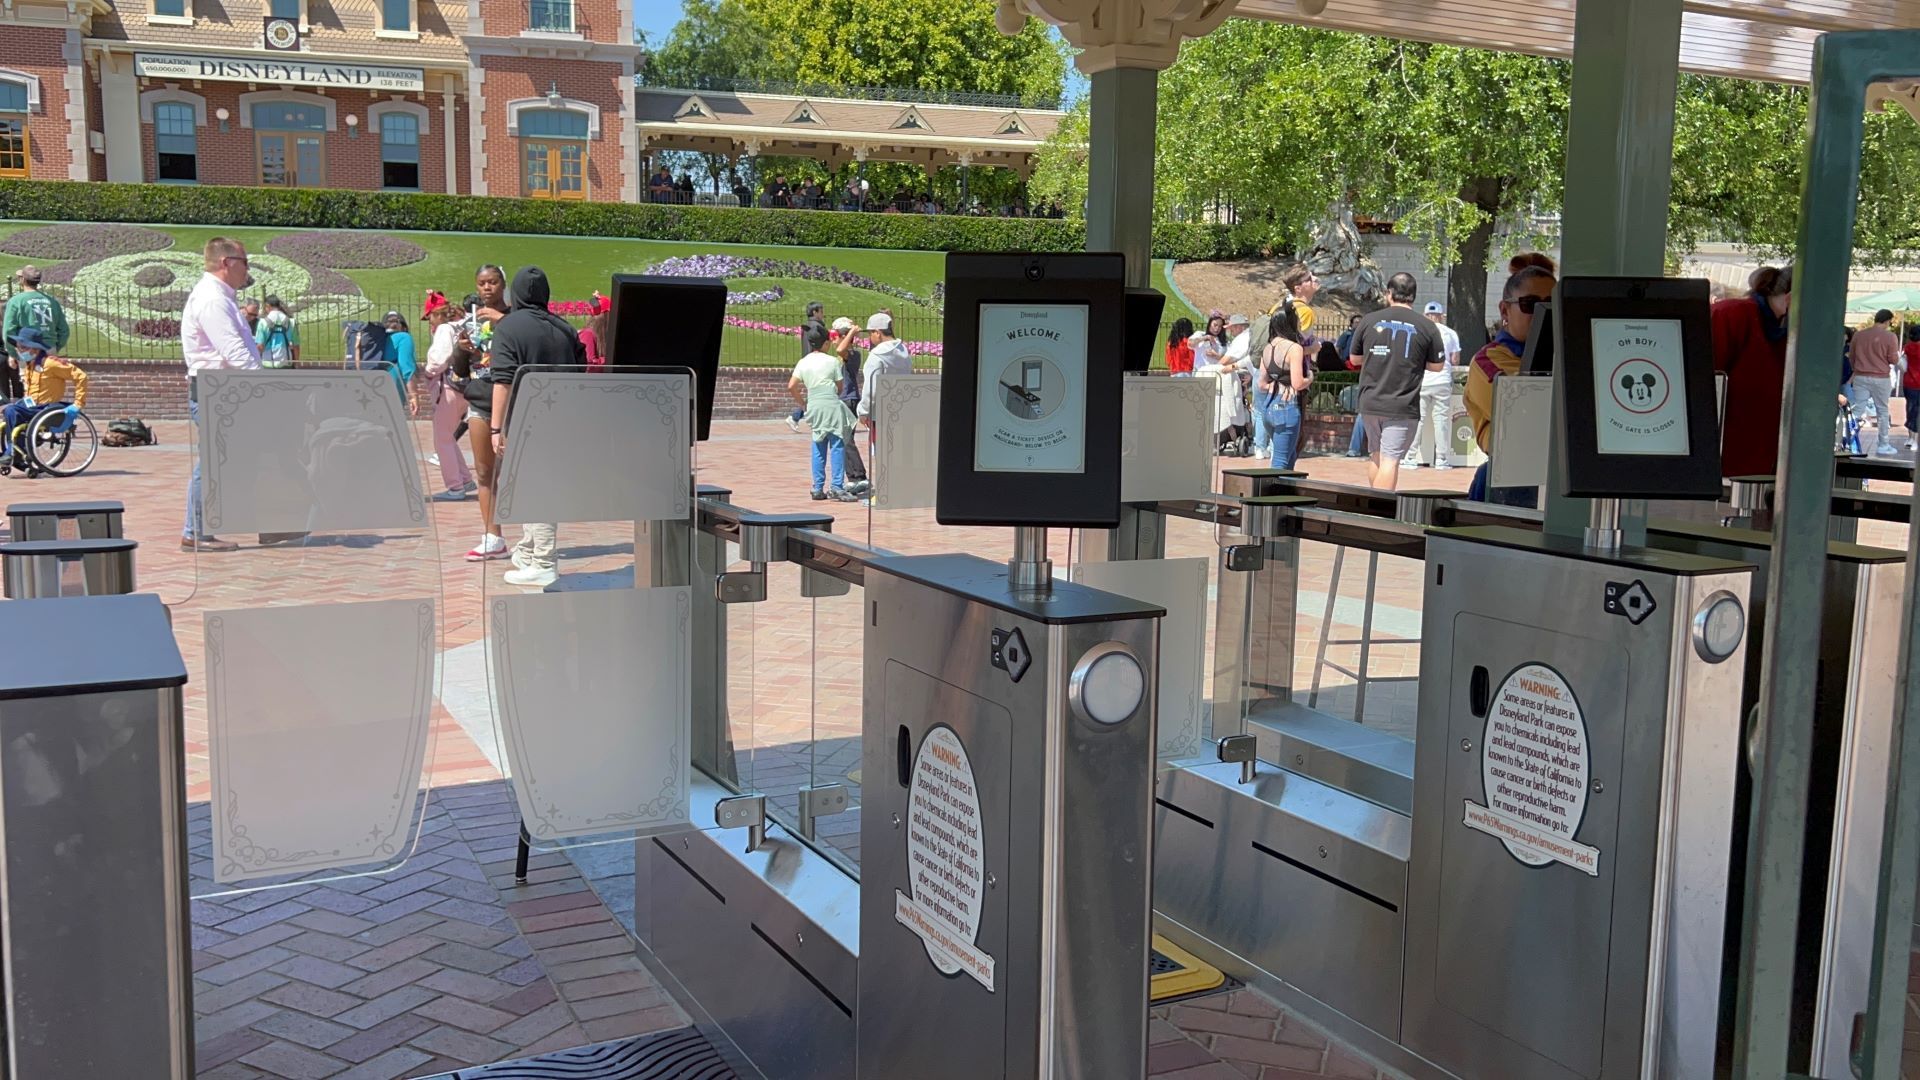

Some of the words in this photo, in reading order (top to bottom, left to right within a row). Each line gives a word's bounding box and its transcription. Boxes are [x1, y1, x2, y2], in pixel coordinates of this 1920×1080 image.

[141, 56, 192, 66] POPULATION
[200, 60, 372, 84] DISNEYLAND
[378, 70, 418, 79] ELEVATION
[1006, 328, 1060, 342] WELCOME
[1618, 338, 1630, 346] OH
[1636, 338, 1656, 348] BOY!
[1610, 418, 1622, 428] THIS
[1652, 420, 1674, 432] CLOSED
[1504, 689, 1520, 704] Some
[1520, 696, 1536, 710] areas
[1536, 702, 1543, 711] or
[1544, 700, 1568, 718] features
[1568, 709, 1574, 720] in
[1520, 677, 1560, 700] WARNING:
[1494, 721, 1504, 732] you
[1504, 722, 1511, 733] to
[1512, 723, 1538, 742] chemicals
[1540, 731, 1566, 753] including
[1567, 739, 1580, 756] lead
[1500, 704, 1530, 722] Disneyland
[1531, 712, 1543, 728] Park
[1545, 721, 1555, 732] can
[1556, 724, 1577, 738] expose
[932, 741, 961, 770] WARNING:
[1488, 746, 1506, 764] known
[1508, 754, 1514, 766] to
[1514, 756, 1524, 770] the
[1524, 759, 1540, 774] State
[1540, 764, 1546, 779] of
[1547, 766, 1574, 785] California
[1575, 777, 1582, 789] to
[1492, 735, 1502, 746] and
[1504, 736, 1516, 751] lead
[1551, 752, 1569, 768] which
[1570, 762, 1580, 772] are
[921, 754, 932, 774] Some
[932, 765, 944, 781] areas
[950, 770, 968, 794] features
[968, 782, 972, 797] in
[1490, 766, 1506, 778] cause
[1507, 772, 1525, 785] cancer
[1526, 779, 1532, 788] or
[1532, 776, 1546, 793] birth
[1548, 782, 1568, 800] defects
[1570, 794, 1576, 803] or
[918, 772, 940, 798] Disneyland
[940, 784, 950, 804] Park
[958, 801, 974, 818] expose
[1496, 782, 1512, 796] other
[1512, 790, 1548, 810] reproductive
[927, 797, 947, 822] chemicals
[948, 810, 966, 837] including
[968, 819, 977, 840] lead
[1493, 795, 1502, 808] For
[1502, 802, 1518, 814] more
[1518, 805, 1551, 826] information
[1552, 821, 1560, 832] go
[913, 811, 921, 825] and
[922, 812, 930, 831] lead
[956, 835, 970, 855] which
[912, 824, 924, 845] known
[937, 842, 948, 861] State
[954, 852, 974, 878] California
[974, 867, 980, 882] to
[913, 850, 924, 866] cause
[925, 858, 938, 874] cancer
[944, 864, 954, 885] birth
[954, 872, 970, 896] defects
[970, 888, 976, 898] or
[918, 870, 930, 887] other
[930, 880, 956, 906] reproductive
[923, 894, 934, 910] more
[934, 898, 958, 926] information
[958, 920, 964, 934] go
